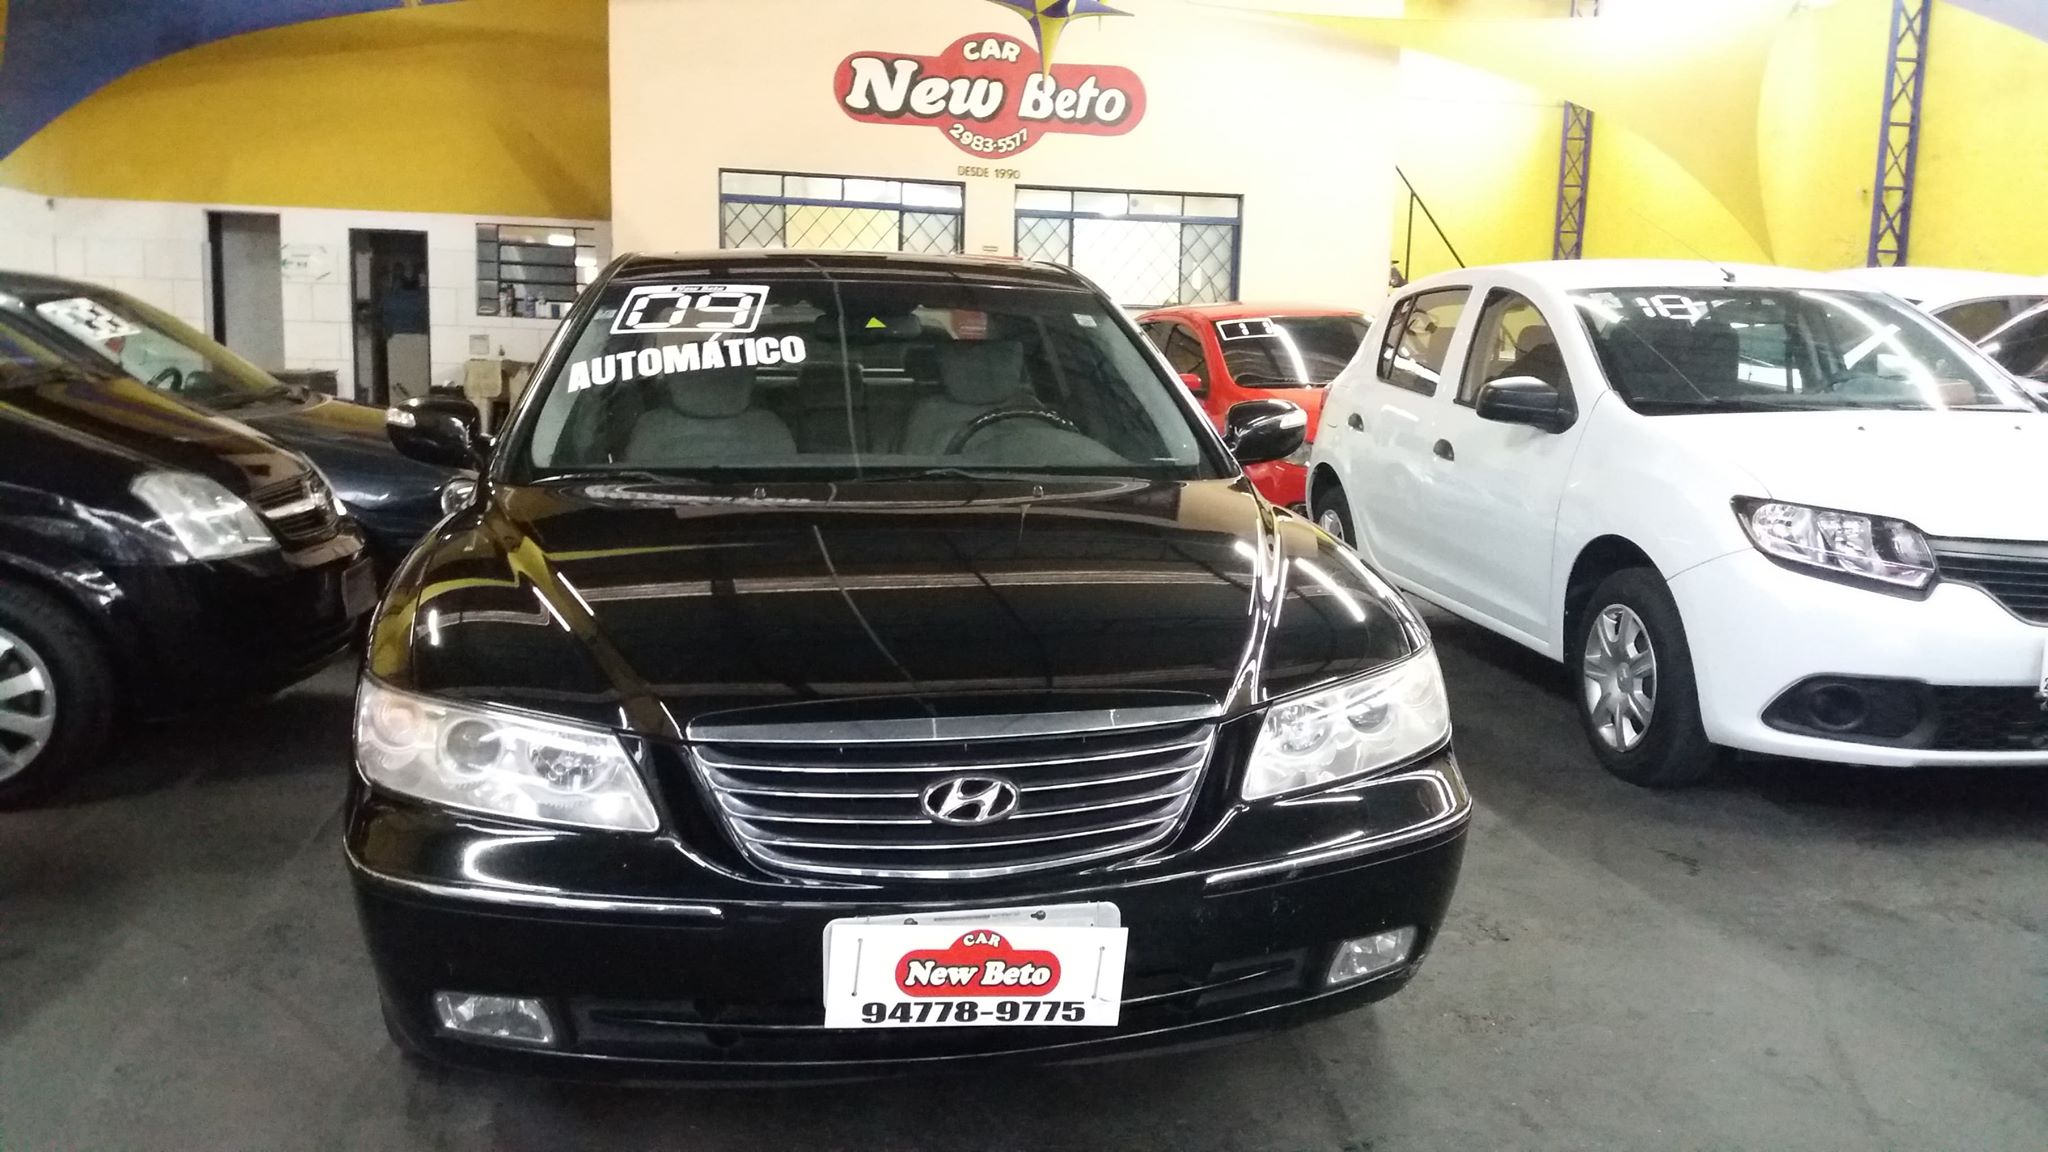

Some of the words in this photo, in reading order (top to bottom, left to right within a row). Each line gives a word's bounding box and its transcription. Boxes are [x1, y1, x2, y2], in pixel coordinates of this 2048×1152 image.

[963, 37, 1020, 62] CAR
[846, 56, 1004, 119] New
[1018, 72, 1127, 122] Beto
[957, 165, 989, 178] DESDE
[994, 168, 1021, 179] 1990
[625, 292, 755, 329] 09
[567, 332, 807, 393] AUTOMÁTICO
[962, 932, 1001, 948] CAR
[904, 960, 979, 986] New
[980, 960, 1051, 986] Beto
[861, 1000, 1086, 1024] 94778-9775
